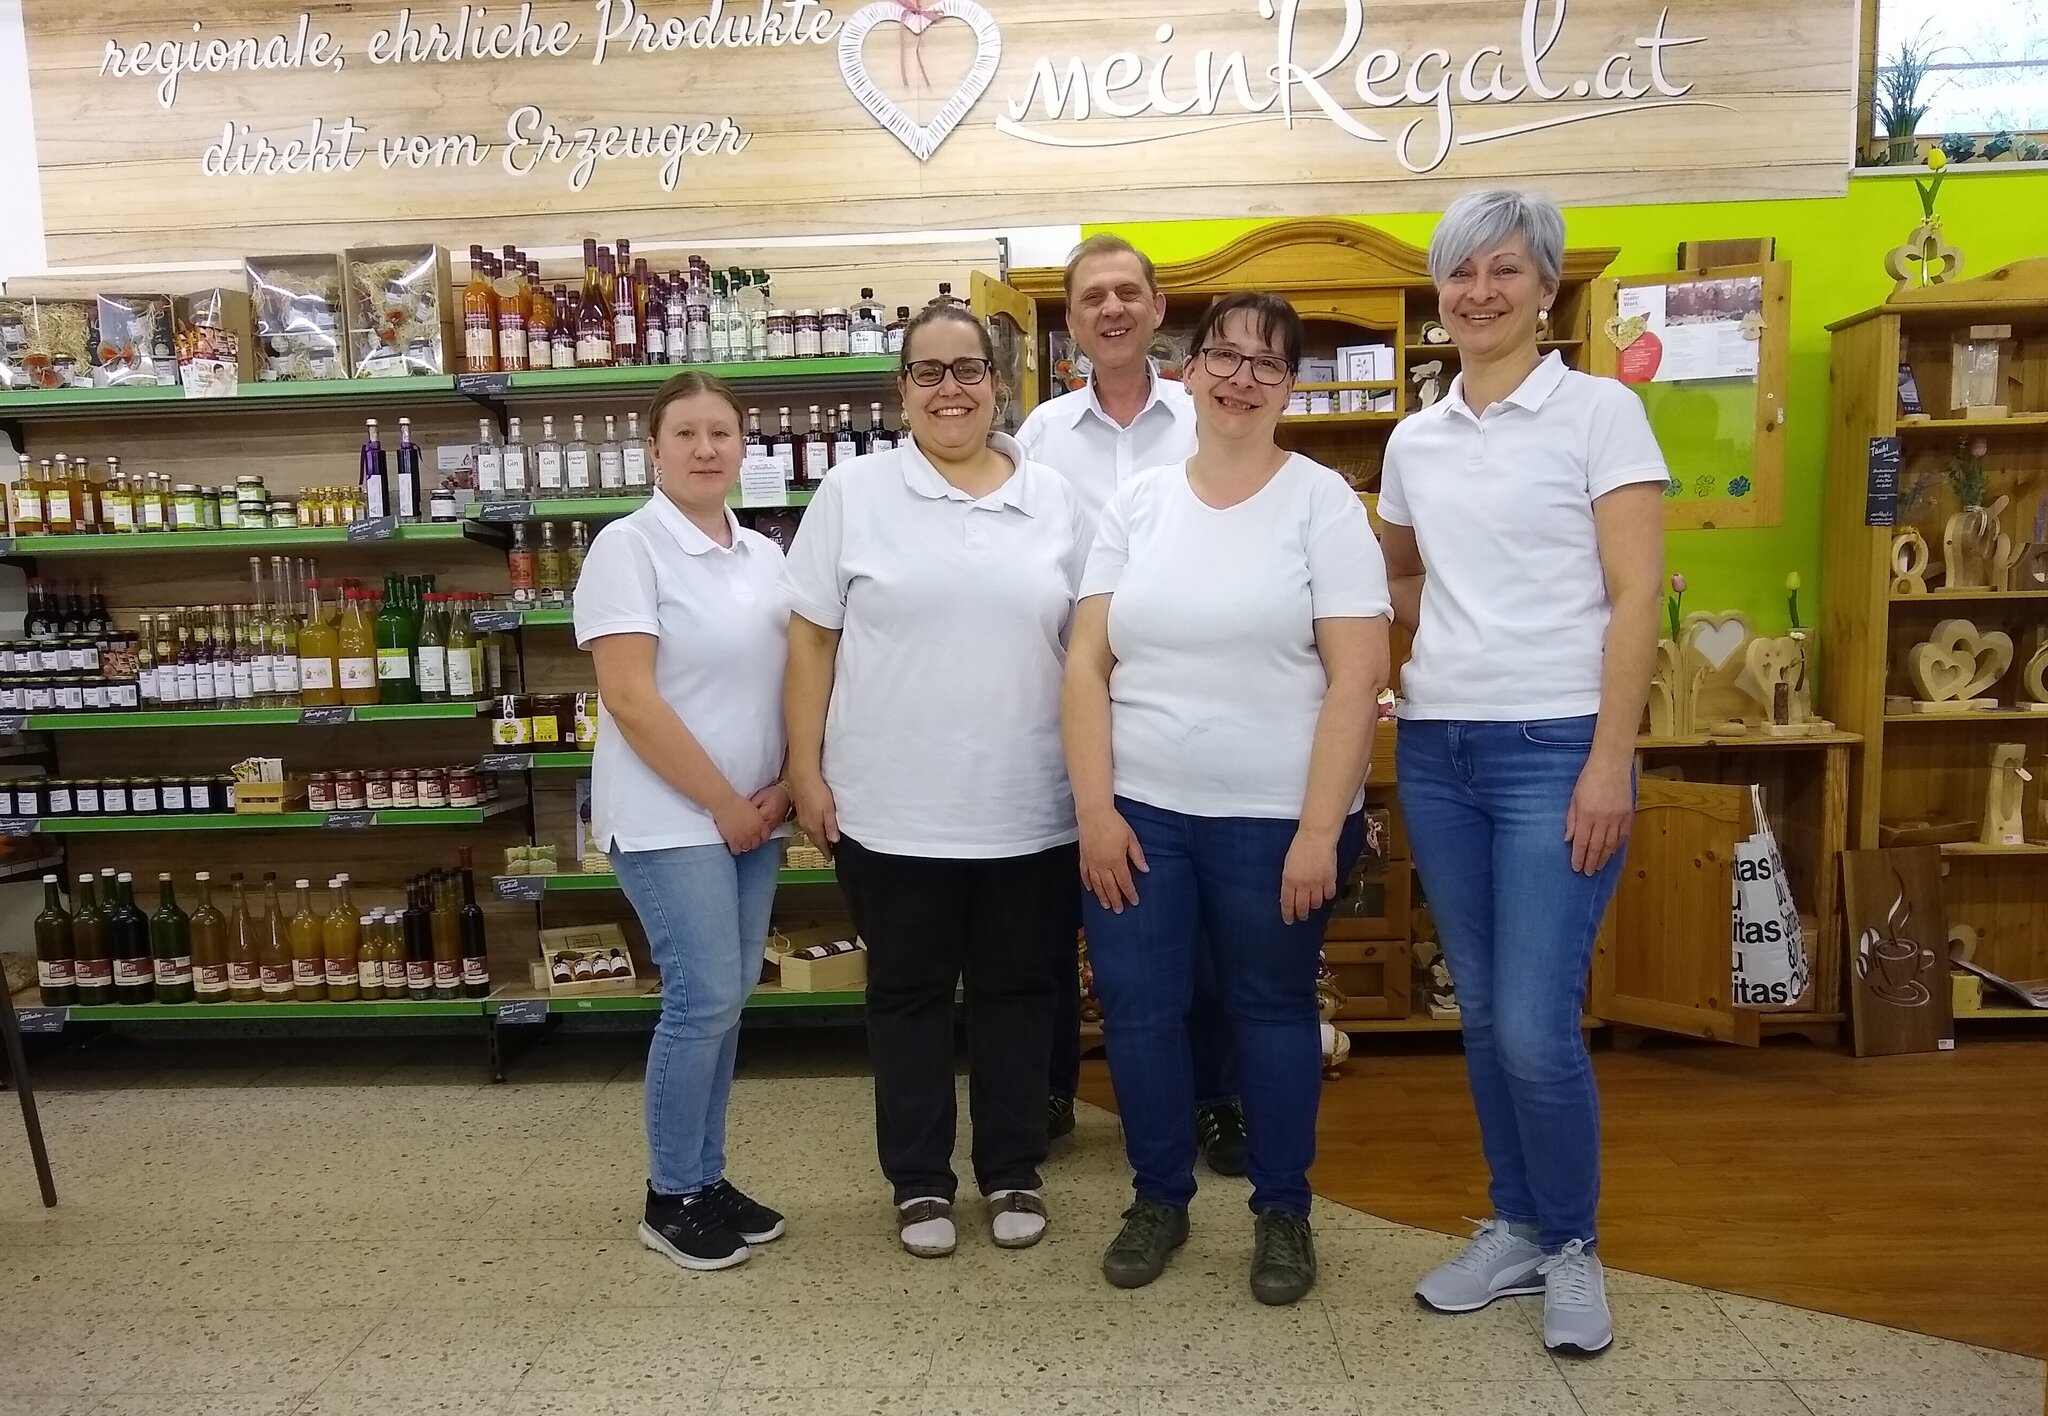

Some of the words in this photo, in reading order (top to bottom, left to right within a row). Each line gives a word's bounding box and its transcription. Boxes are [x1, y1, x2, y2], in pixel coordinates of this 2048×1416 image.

[99, 13, 346, 109] regionale,
[368, 2, 582, 64] ehrliche
[592, 0, 845, 66] Produkte
[1007, 0, 1708, 173] meinRegal.at
[202, 116, 367, 178] direkt
[377, 133, 492, 170] vom
[502, 105, 753, 193] Erzeuger
[483, 460, 496, 469] Gin
[507, 458, 519, 467] Gin
[543, 458, 555, 466] Gin
